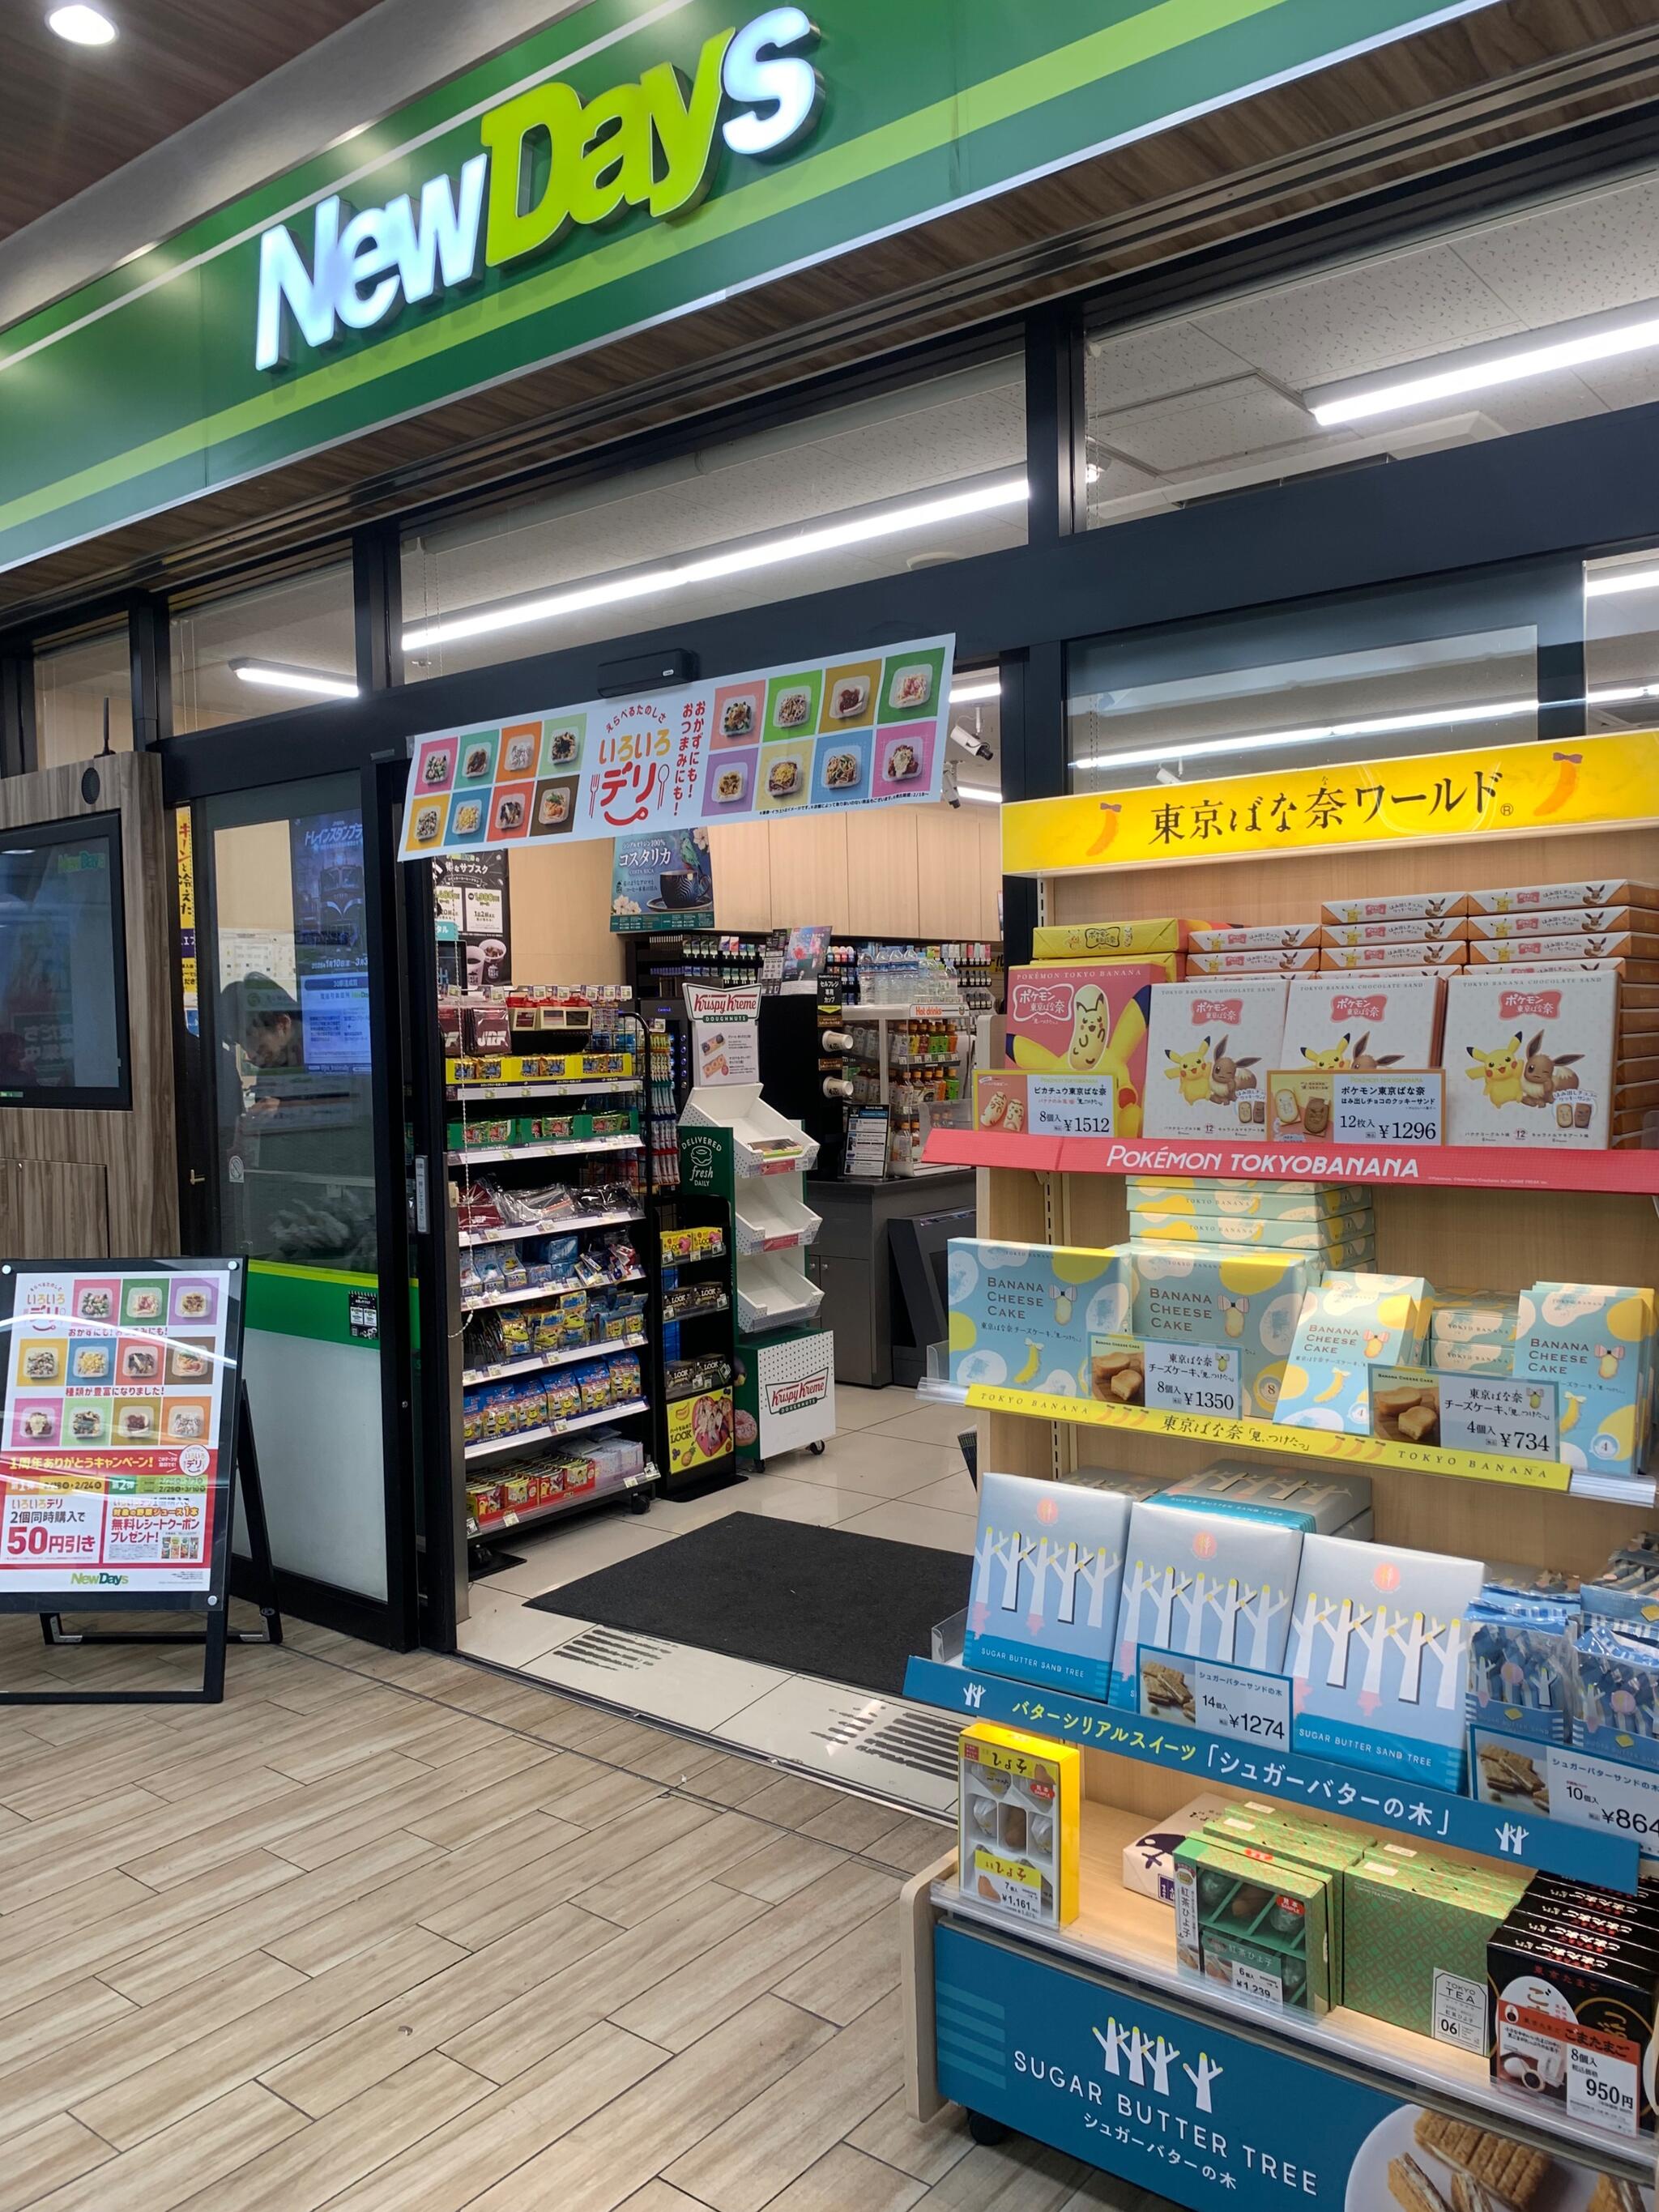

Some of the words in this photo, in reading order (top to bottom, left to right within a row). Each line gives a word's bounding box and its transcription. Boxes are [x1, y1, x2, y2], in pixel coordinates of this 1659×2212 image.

[256, 6, 817, 370] NewDays
[606, 705, 667, 733] えらべるたのしさ
[599, 728, 671, 765] いろいろ
[688, 701, 706, 798] おかずにも!
[673, 703, 693, 816] おつまみにも!
[599, 761, 657, 807] デリ
[1149, 771, 1503, 845] 東京ばな奈ワールド
[619, 847, 672, 867] コスタリカ
[178, 822, 194, 915] キーンと冷えた
[1017, 971, 1060, 981] POKÉMON
[1064, 970, 1095, 978] TOKYO
[1100, 970, 1141, 978] BANANA
[693, 994, 727, 1014] Krispy
[727, 994, 758, 1012] Kreme
[1020, 988, 1056, 1004] ポケモン
[1337, 998, 1370, 1009] ポケモン
[1505, 993, 1545, 1005] ポケモン
[915, 1005, 926, 1016] Hot
[926, 1005, 943, 1016] drinks
[1030, 1000, 1065, 1013] 東京ばな奈
[1196, 1002, 1226, 1012] ポケモン
[1516, 1001, 1554, 1015] 東京ばな奈
[1034, 1086, 1107, 1096] ピカチュウ東京ばな奈
[1341, 1086, 1426, 1095] ポケモン東京ばな奈
[1341, 1097, 1435, 1106] はみ出しチョコのクッキーサンド
[1039, 1110, 1062, 1123] 8個入
[1064, 1117, 1110, 1132] ¥1512
[1340, 1115, 1375, 1128] 12枚入
[1379, 1121, 1437, 1140] ¥1296
[1516, 1129, 1526, 1138] 12
[681, 1136, 723, 1153] DELIVERED
[1106, 1145, 1222, 1171] POKÉMON
[1230, 1153, 1419, 1178] TOKYOBANANA
[689, 1165, 714, 1181] fresh
[693, 1179, 710, 1187] DAILY
[701, 1288, 716, 1297] LOOK
[987, 1276, 1044, 1293] BANANA
[27, 1293, 65, 1305] いろいろ
[671, 1294, 687, 1304] LOOK
[987, 1291, 1044, 1307] CHEESE
[1149, 1288, 1213, 1304] BANANA
[987, 1306, 1026, 1319] CAKE
[1150, 1302, 1213, 1319] CHEESE
[981, 1321, 1013, 1333] 東京ばな奈
[1151, 1318, 1192, 1332] CAKE
[1309, 1323, 1359, 1336] BANANA
[1448, 1323, 1473, 1332] TOKYO
[1476, 1326, 1509, 1335] BANANA
[1306, 1334, 1357, 1346] CHEESE
[1530, 1338, 1589, 1352] BANANA
[1303, 1344, 1337, 1354] CAKE
[1529, 1350, 1588, 1364] CHEESE
[1168, 1353, 1213, 1367] 東京ばな奈
[1447, 1352, 1473, 1361] TOKYO
[1475, 1355, 1508, 1364] BANANA
[1528, 1362, 1567, 1375] CAKE
[66, 1387, 164, 1397] 種類が豊富になりました!
[771, 1385, 800, 1407] Krispy
[797, 1377, 825, 1398] Kreme
[1157, 1381, 1182, 1395] 8個入
[1183, 1391, 1235, 1411] ¥1350
[1268, 1384, 1275, 1395] 8
[1469, 1387, 1523, 1404] 東京ばな奈
[780, 1398, 817, 1414] DOUGHNUTS
[980, 1392, 1024, 1405] TOKYO
[1031, 1399, 1089, 1415] BANANA
[670, 1430, 693, 1445] LOOK
[1466, 1421, 1496, 1436] 4個入
[1499, 1431, 1550, 1452] ¥734
[10, 1456, 154, 1470] 1周年ありがとうキャンペーン!
[186, 1459, 203, 1468] デリ
[1398, 1449, 1456, 1467] TOKYO
[1469, 1459, 1548, 1481] BANANA
[11, 1498, 63, 1510] いろいろデリ
[10, 1511, 86, 1524] 2個同時購入で
[111, 1518, 200, 1531] 無料レシートクーポン
[6, 1526, 96, 1555] 50円引き
[111, 1532, 159, 1544] プレゼント!
[70, 1572, 129, 1586] NewDays
[981, 1647, 1006, 1661] SUGAR
[1009, 1653, 1038, 1669] BUTTER
[1041, 1662, 1062, 1674] SAND
[1064, 1668, 1085, 1679] TREE
[1199, 1671, 1283, 1698] シュガーバターサンドの木
[1202, 1694, 1228, 1711] 14個入
[1229, 1712, 1285, 1740] ¥1274
[1299, 1727, 1331, 1744] SUGAR
[1334, 1735, 1372, 1753] BUTTER
[1375, 1746, 1403, 1761] SAND
[1406, 1753, 1432, 1767] TREE
[992, 1752, 1028, 1774] ひよ子
[1011, 1701, 1197, 1762] バターシリアルスイーツ
[1206, 1744, 1451, 1835] 「シュガーバターの木」
[1566, 1785, 1599, 1805] 10個入
[1601, 1808, 1659, 1838] ¥864
[1001, 1894, 1031, 1912] ¥1,161
[1180, 1886, 1191, 1938] 紅茶ひよ子
[1229, 1943, 1273, 1967] 紅茶ひよ子
[1445, 1987, 1476, 2005] TEA
[1446, 1980, 1476, 1997] TOKYO
[1440, 2018, 1458, 2035] 06
[1564, 2027, 1630, 2059] ごまたまご
[1571, 2048, 1598, 2068] 8個入
[1585, 2078, 1634, 2110] 950円
[1013, 2050, 1102, 2107] SUGAR
[1117, 2092, 1229, 2159] BUTTER
[1242, 2146, 1318, 2197] TREE
[1083, 2112, 1238, 2190] シュガーバターの木
